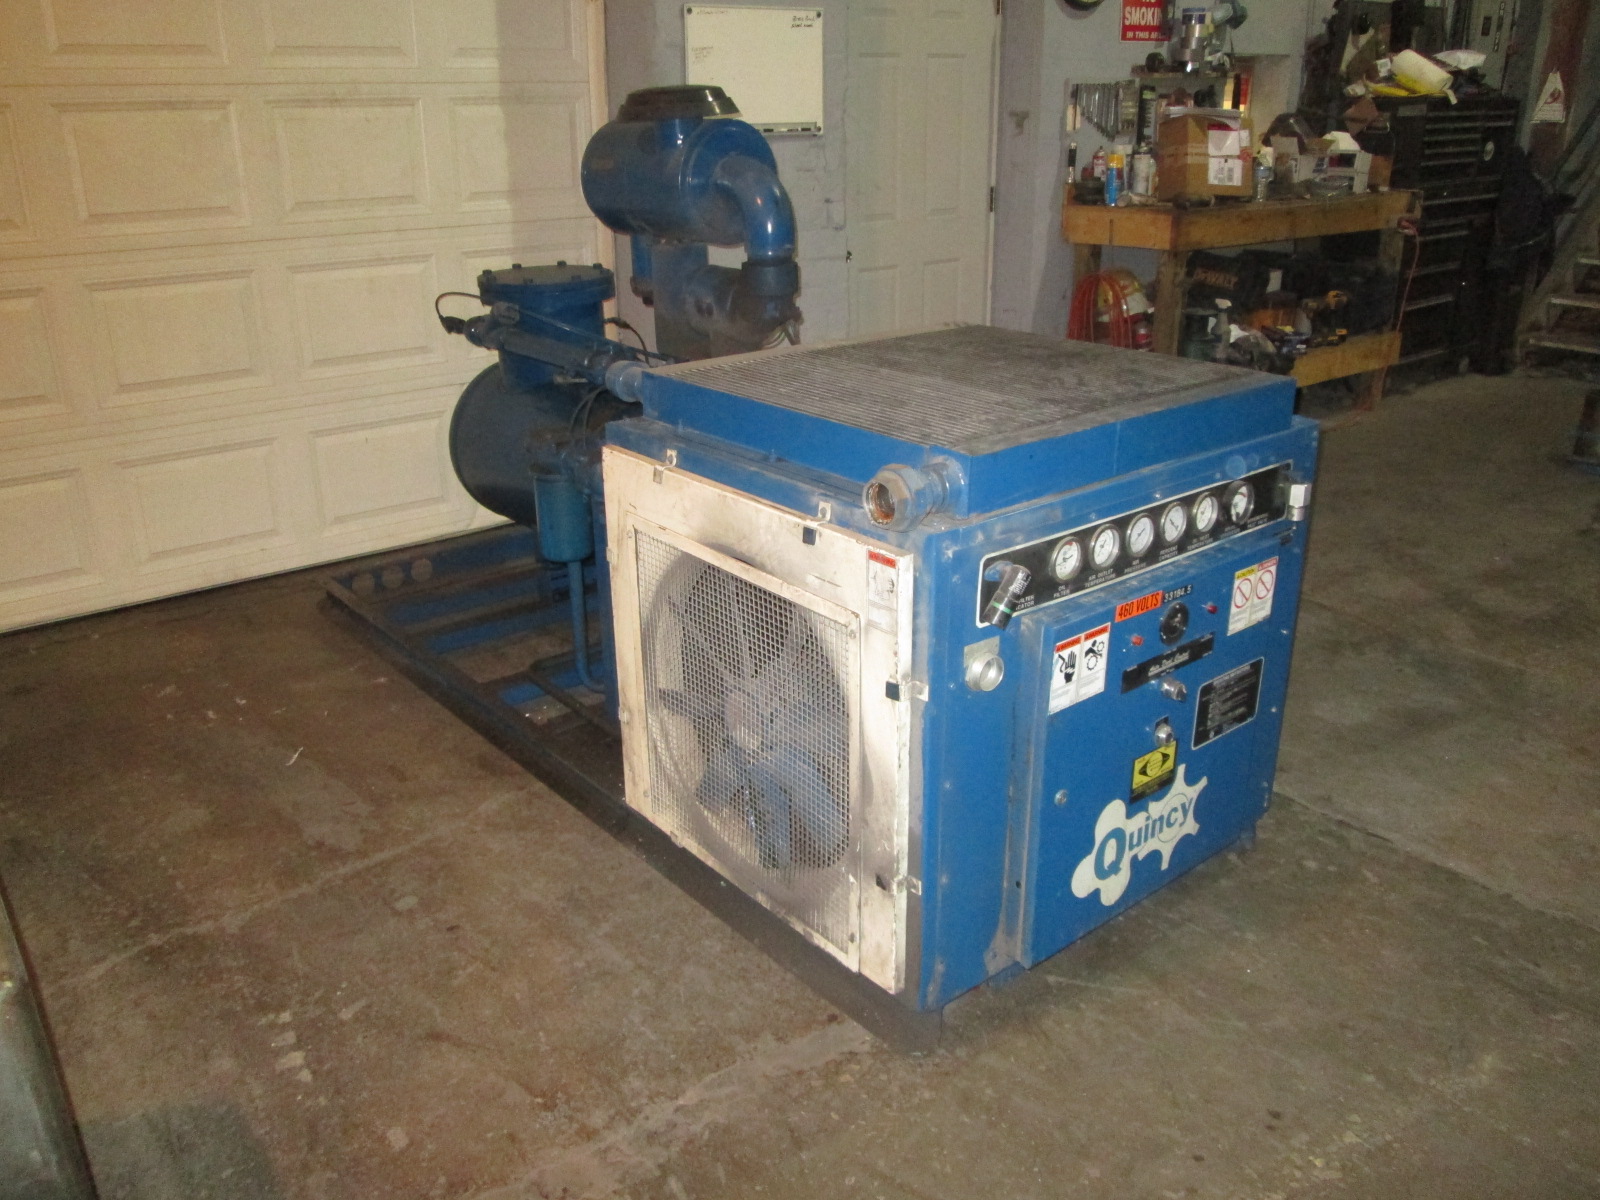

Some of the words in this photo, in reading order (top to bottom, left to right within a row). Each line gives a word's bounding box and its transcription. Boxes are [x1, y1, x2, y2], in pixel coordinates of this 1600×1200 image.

[1124, 6, 1163, 26] SMOKIN
[1126, 31, 1134, 39] IN
[1135, 31, 1149, 39] THIS
[1053, 589, 1070, 598] FILTER
[1118, 601, 1135, 619] 460
[1136, 592, 1160, 613] VOLTS
[1094, 796, 1194, 881] Quincy
